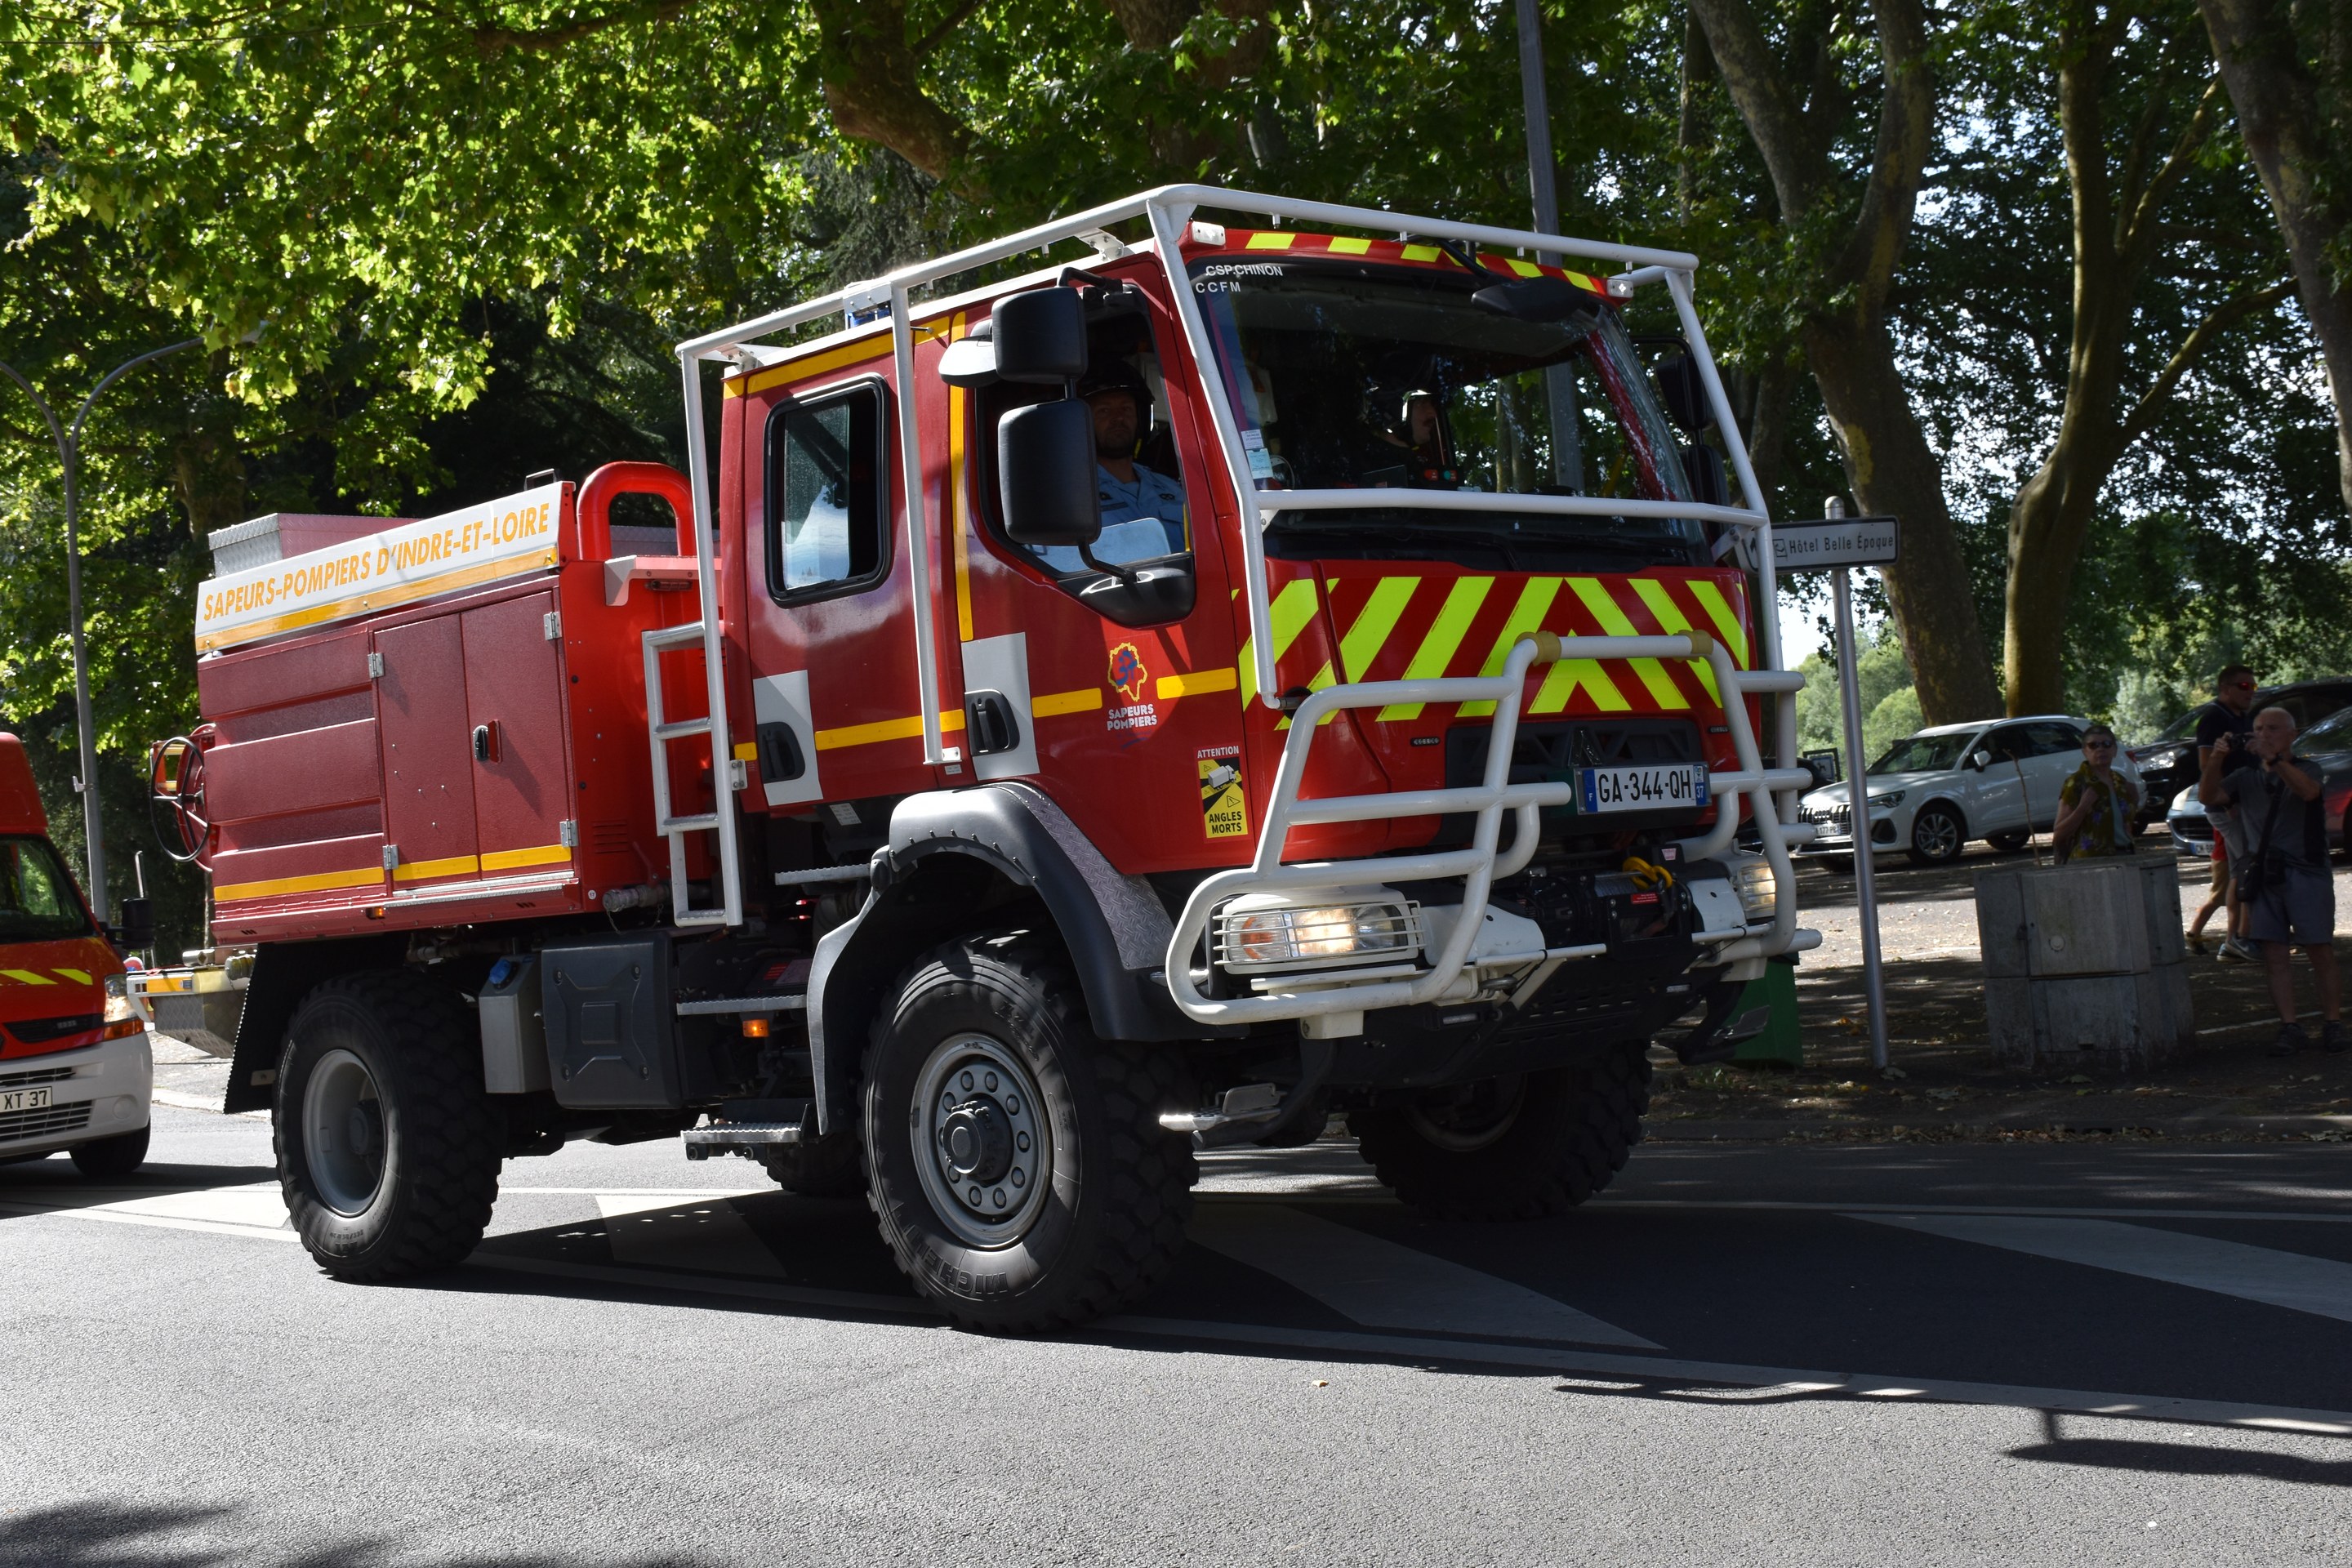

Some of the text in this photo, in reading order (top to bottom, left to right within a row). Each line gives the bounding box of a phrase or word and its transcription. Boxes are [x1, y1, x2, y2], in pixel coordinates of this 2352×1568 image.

[1788, 533, 1894, 554] Hôtel Belle Époque
[203, 550, 372, 621] SAPEURS-POMPIERS
[1108, 704, 1154, 719] SAPEURS
[1107, 715, 1157, 731] POMPIERS
[1197, 746, 1239, 759] ATTENTION
[1598, 770, 1692, 803] GA-344-QH
[1695, 786, 1704, 799] 37
[1209, 811, 1242, 823] ANGLES
[1211, 822, 1242, 834] MORTS
[4, 1090, 47, 1110] XT 37
